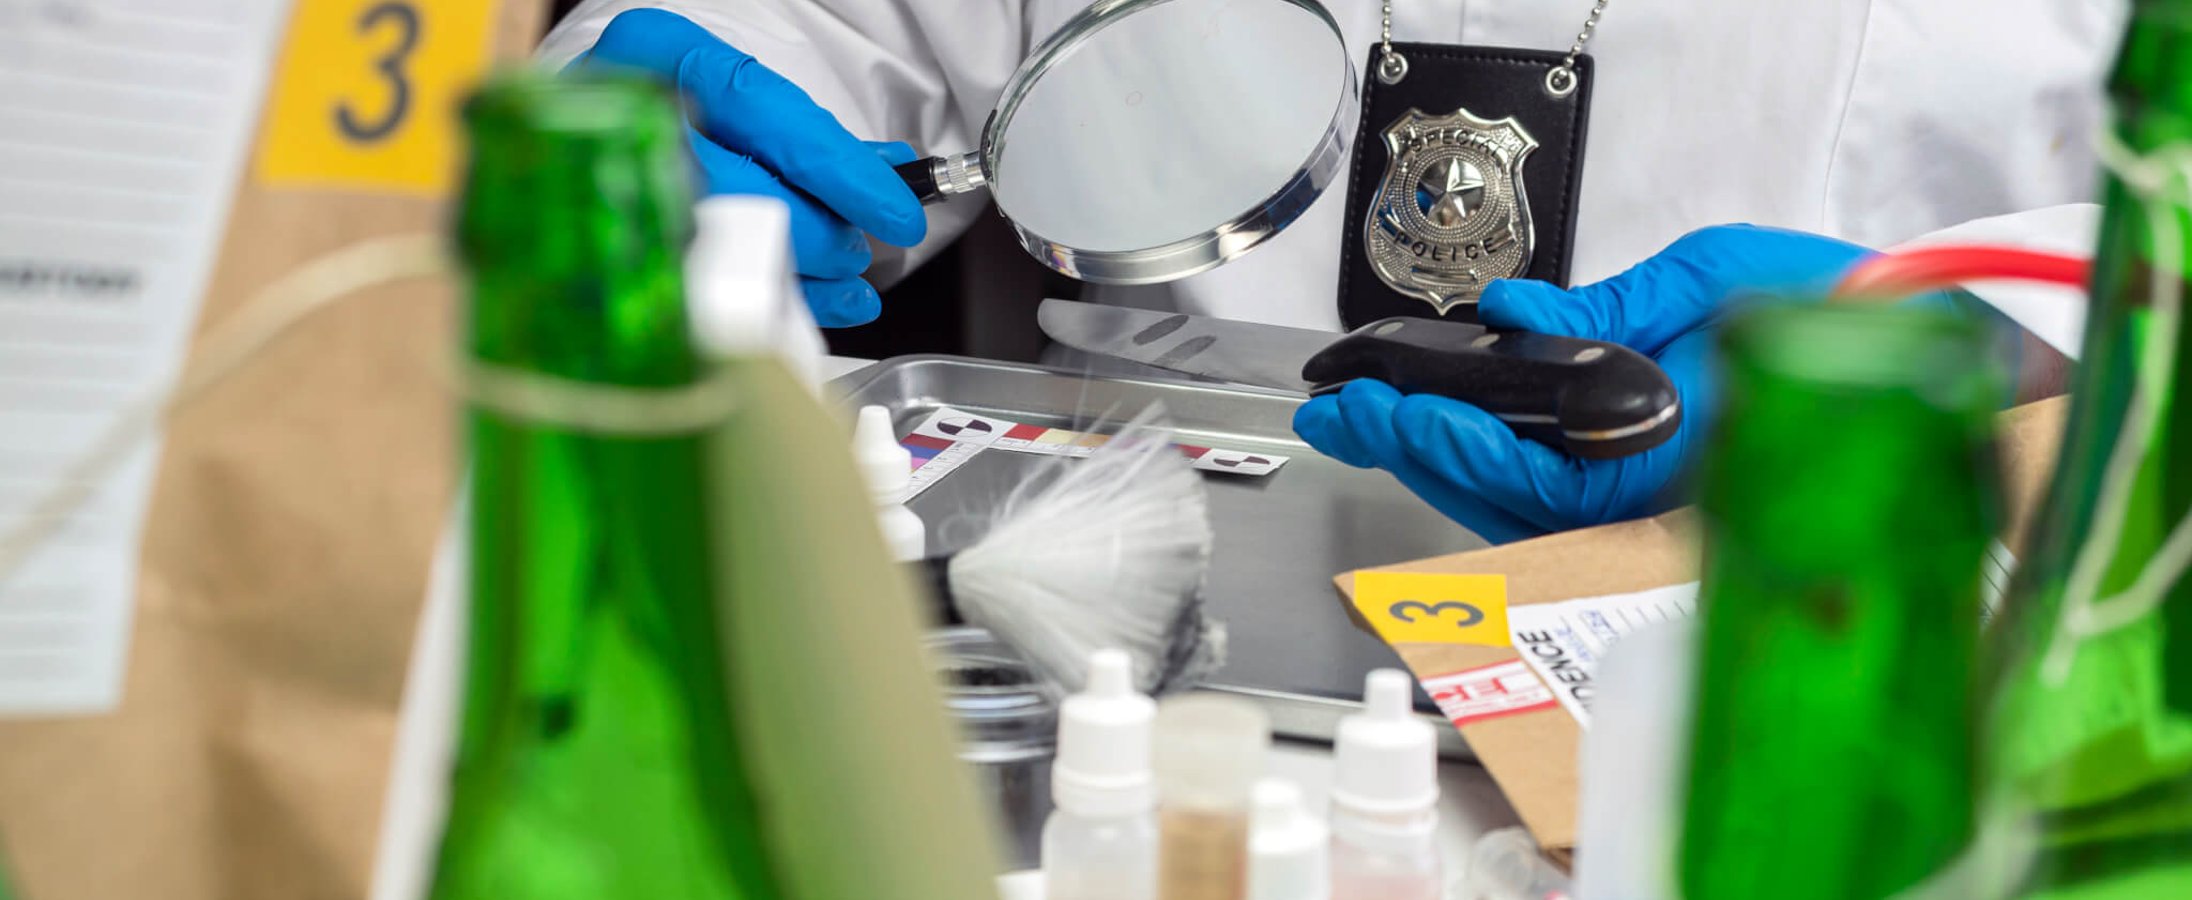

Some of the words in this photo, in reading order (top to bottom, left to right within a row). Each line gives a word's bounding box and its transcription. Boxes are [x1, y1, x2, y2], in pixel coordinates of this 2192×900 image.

[334, 1, 422, 141] 3
[1395, 232, 1497, 262] POLICE
[1389, 601, 1484, 627] 3
[1517, 630, 1594, 710] DENCE
